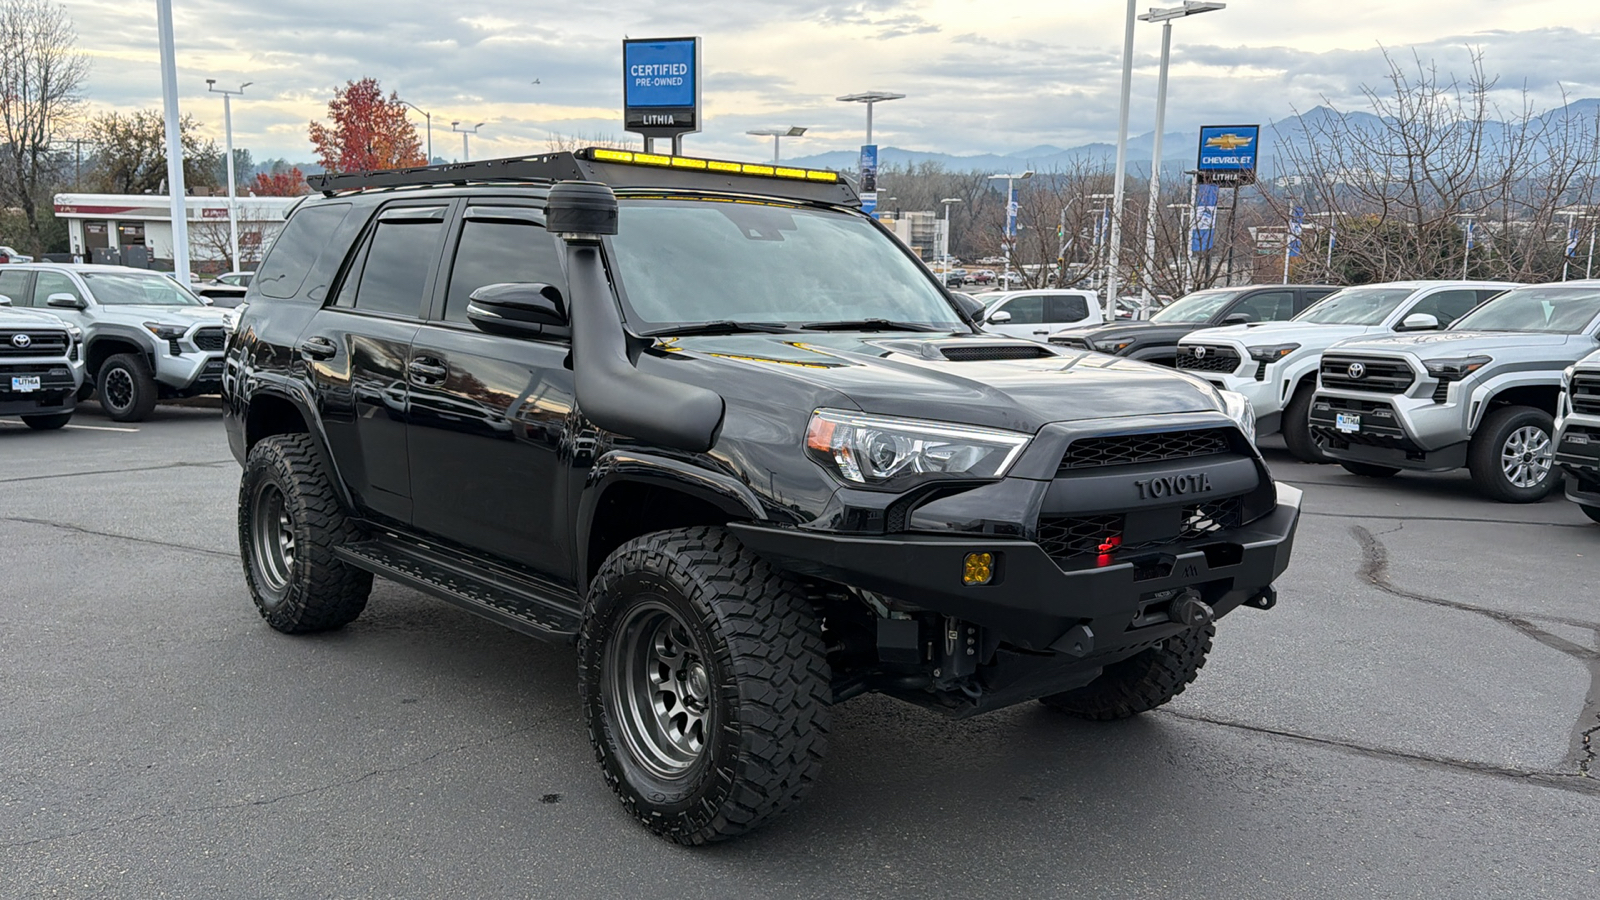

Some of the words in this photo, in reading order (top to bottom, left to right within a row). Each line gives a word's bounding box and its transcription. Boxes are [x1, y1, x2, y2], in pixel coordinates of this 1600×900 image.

[630, 63, 688, 77] CERTIFIED
[635, 77, 683, 87] PRE-OWNED
[643, 114, 675, 125] LITHIA
[1212, 173, 1238, 181] LITHIA
[1134, 472, 1213, 499] TOYOTA
